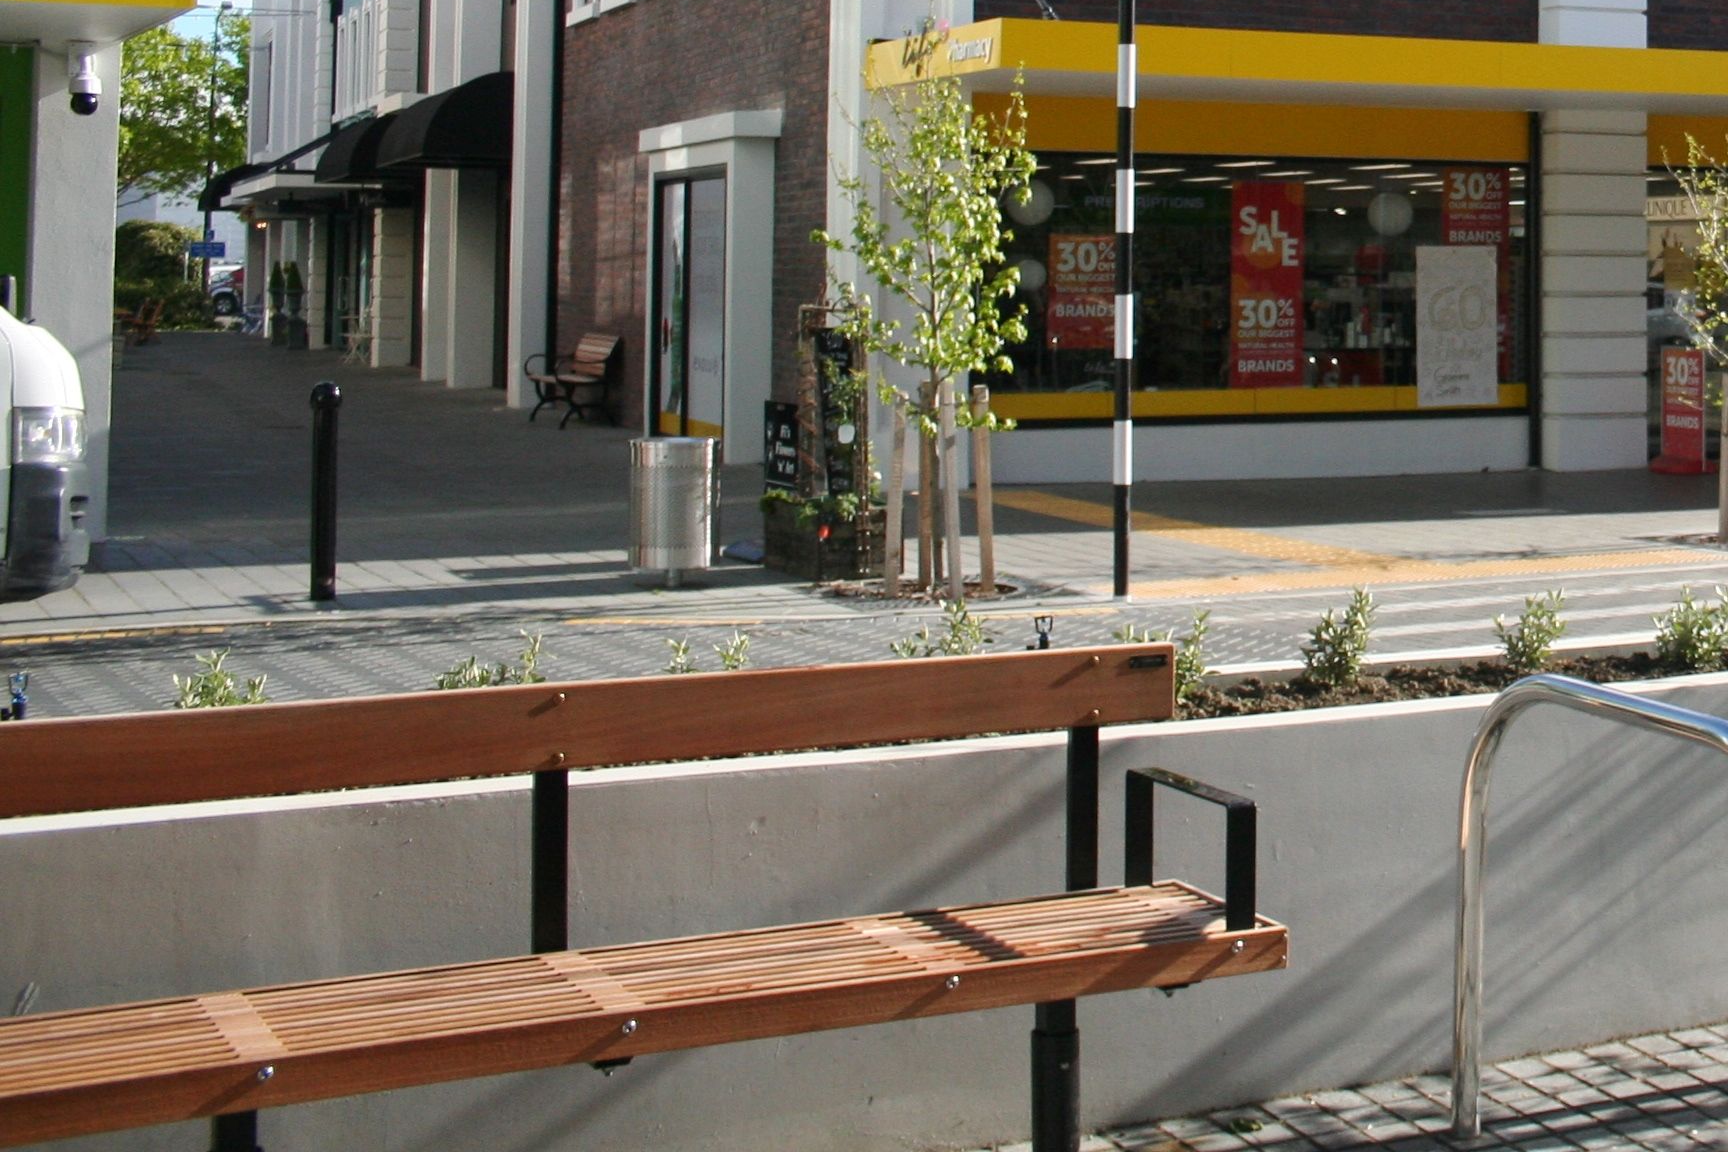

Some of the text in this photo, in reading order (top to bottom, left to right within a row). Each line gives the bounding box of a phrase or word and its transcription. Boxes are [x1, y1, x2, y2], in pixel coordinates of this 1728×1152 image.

[1448, 172, 1502, 200] 30%
[1085, 196, 1205, 208] PRERIPTIONS
[1647, 199, 1689, 218] LINIQUE
[1239, 205, 1300, 266] SALE
[1449, 230, 1502, 243] BRANDS
[1056, 242, 1116, 272] 30%
[1238, 299, 1295, 328] 30%
[1276, 318, 1296, 328] OFF
[1238, 359, 1296, 373] BRANDS
[1665, 356, 1699, 385] 30%
